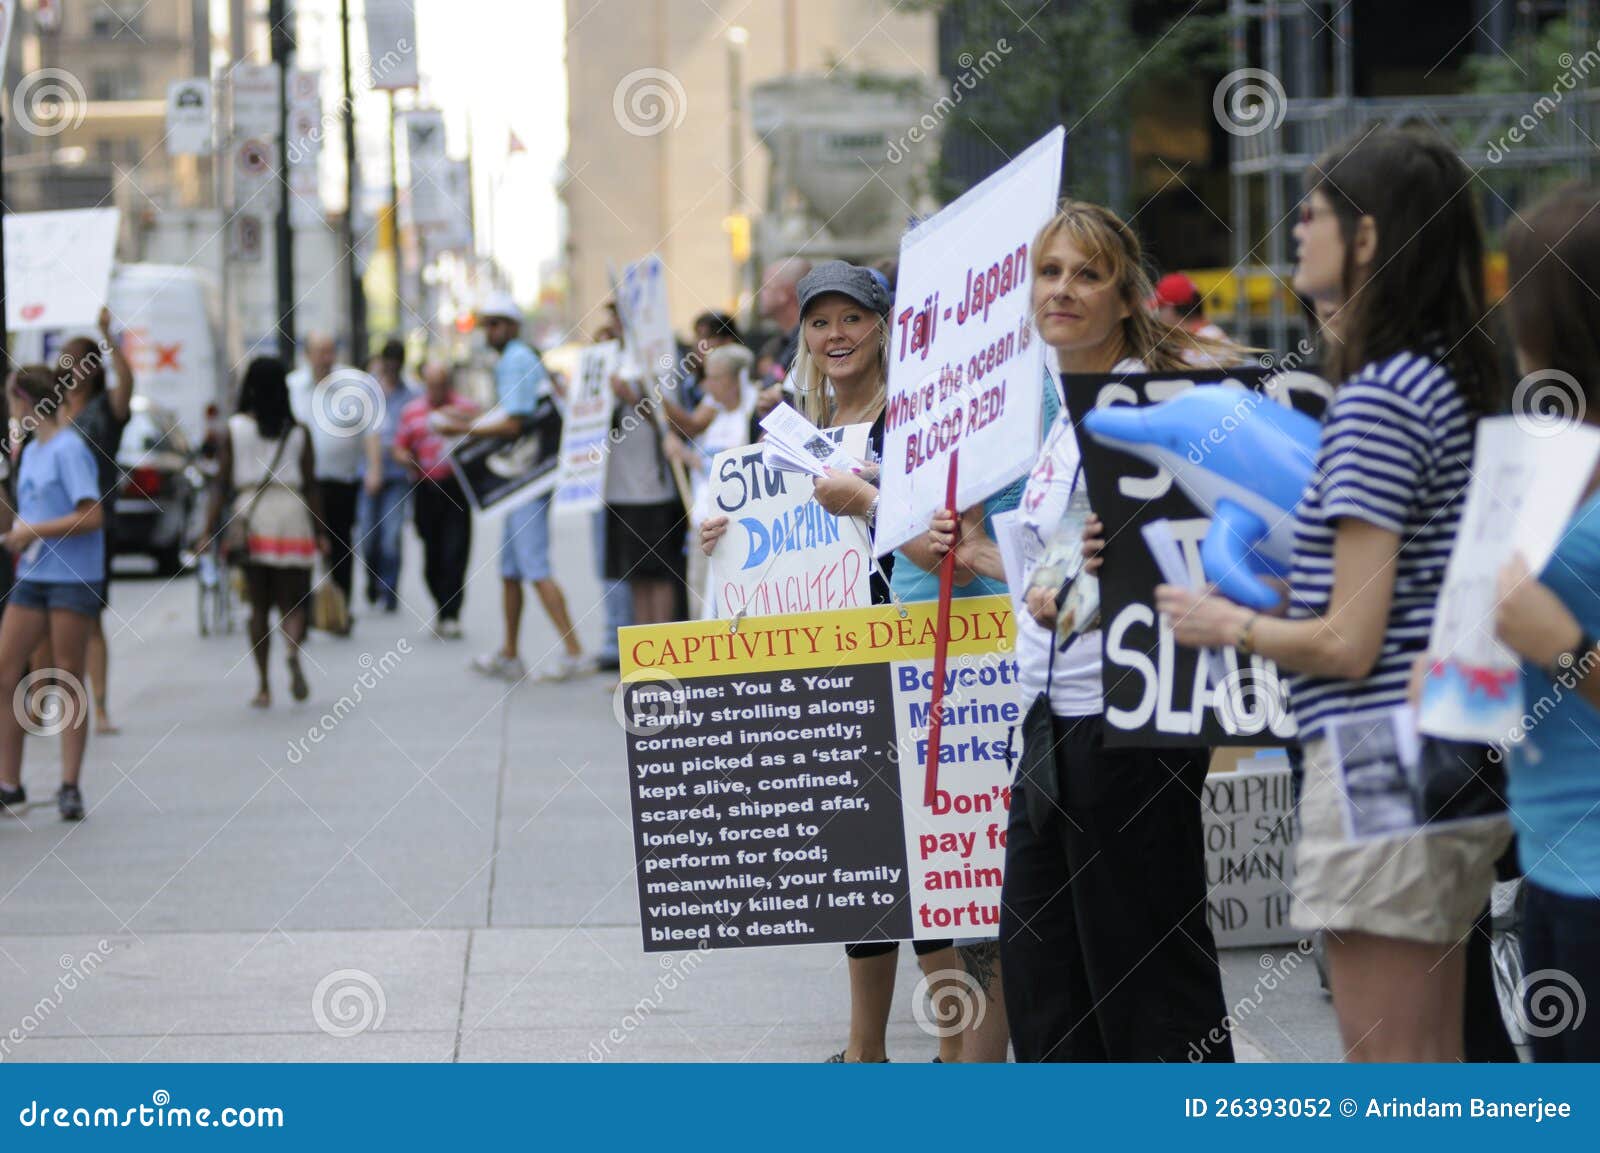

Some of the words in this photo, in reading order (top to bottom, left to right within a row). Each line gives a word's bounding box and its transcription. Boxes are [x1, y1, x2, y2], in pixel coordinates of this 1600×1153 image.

[957, 243, 1027, 325] Japan
[885, 381, 935, 433] Where
[939, 363, 963, 402] the
[968, 332, 1014, 384] ocean
[1018, 316, 1031, 354] is
[905, 408, 963, 474] BLOOD
[966, 380, 1007, 437] RED!
[738, 500, 841, 570] DOLPHIN
[632, 626, 824, 668] CAPTIVITY
[835, 625, 858, 651] is
[866, 610, 1011, 649] DEADLY
[632, 686, 725, 704] Imagine:
[731, 682, 772, 696] You
[779, 678, 796, 692] &
[803, 675, 854, 690] Your
[633, 710, 704, 727] Family
[711, 703, 801, 720] strolling
[808, 700, 875, 715] along;
[909, 699, 1019, 728] Marine
[635, 731, 733, 751] cornered
[740, 722, 862, 744] innocently;
[637, 761, 675, 778] you
[681, 753, 753, 775] picked
[760, 755, 785, 767] as
[792, 754, 806, 765] a
[639, 782, 686, 800] kept
[693, 780, 751, 796] alive,
[757, 771, 859, 791] confined,
[640, 804, 722, 822] scared,
[728, 799, 814, 818] shipped
[820, 796, 870, 812] afar,
[643, 829, 713, 846] lonely,
[719, 824, 789, 842] forced
[796, 823, 819, 836] to
[919, 832, 977, 860] pay
[645, 852, 730, 873] perform
[736, 850, 768, 864] for
[773, 846, 828, 862] food;
[647, 873, 772, 893] meanwhile,
[778, 872, 827, 889] your
[833, 866, 901, 884] family
[648, 899, 742, 917] violently
[749, 895, 809, 912] killed
[814, 894, 822, 908] /
[828, 893, 864, 908] left
[872, 891, 894, 905] to
[651, 926, 710, 941] bleed
[717, 923, 739, 937] to
[746, 919, 815, 936] death.
